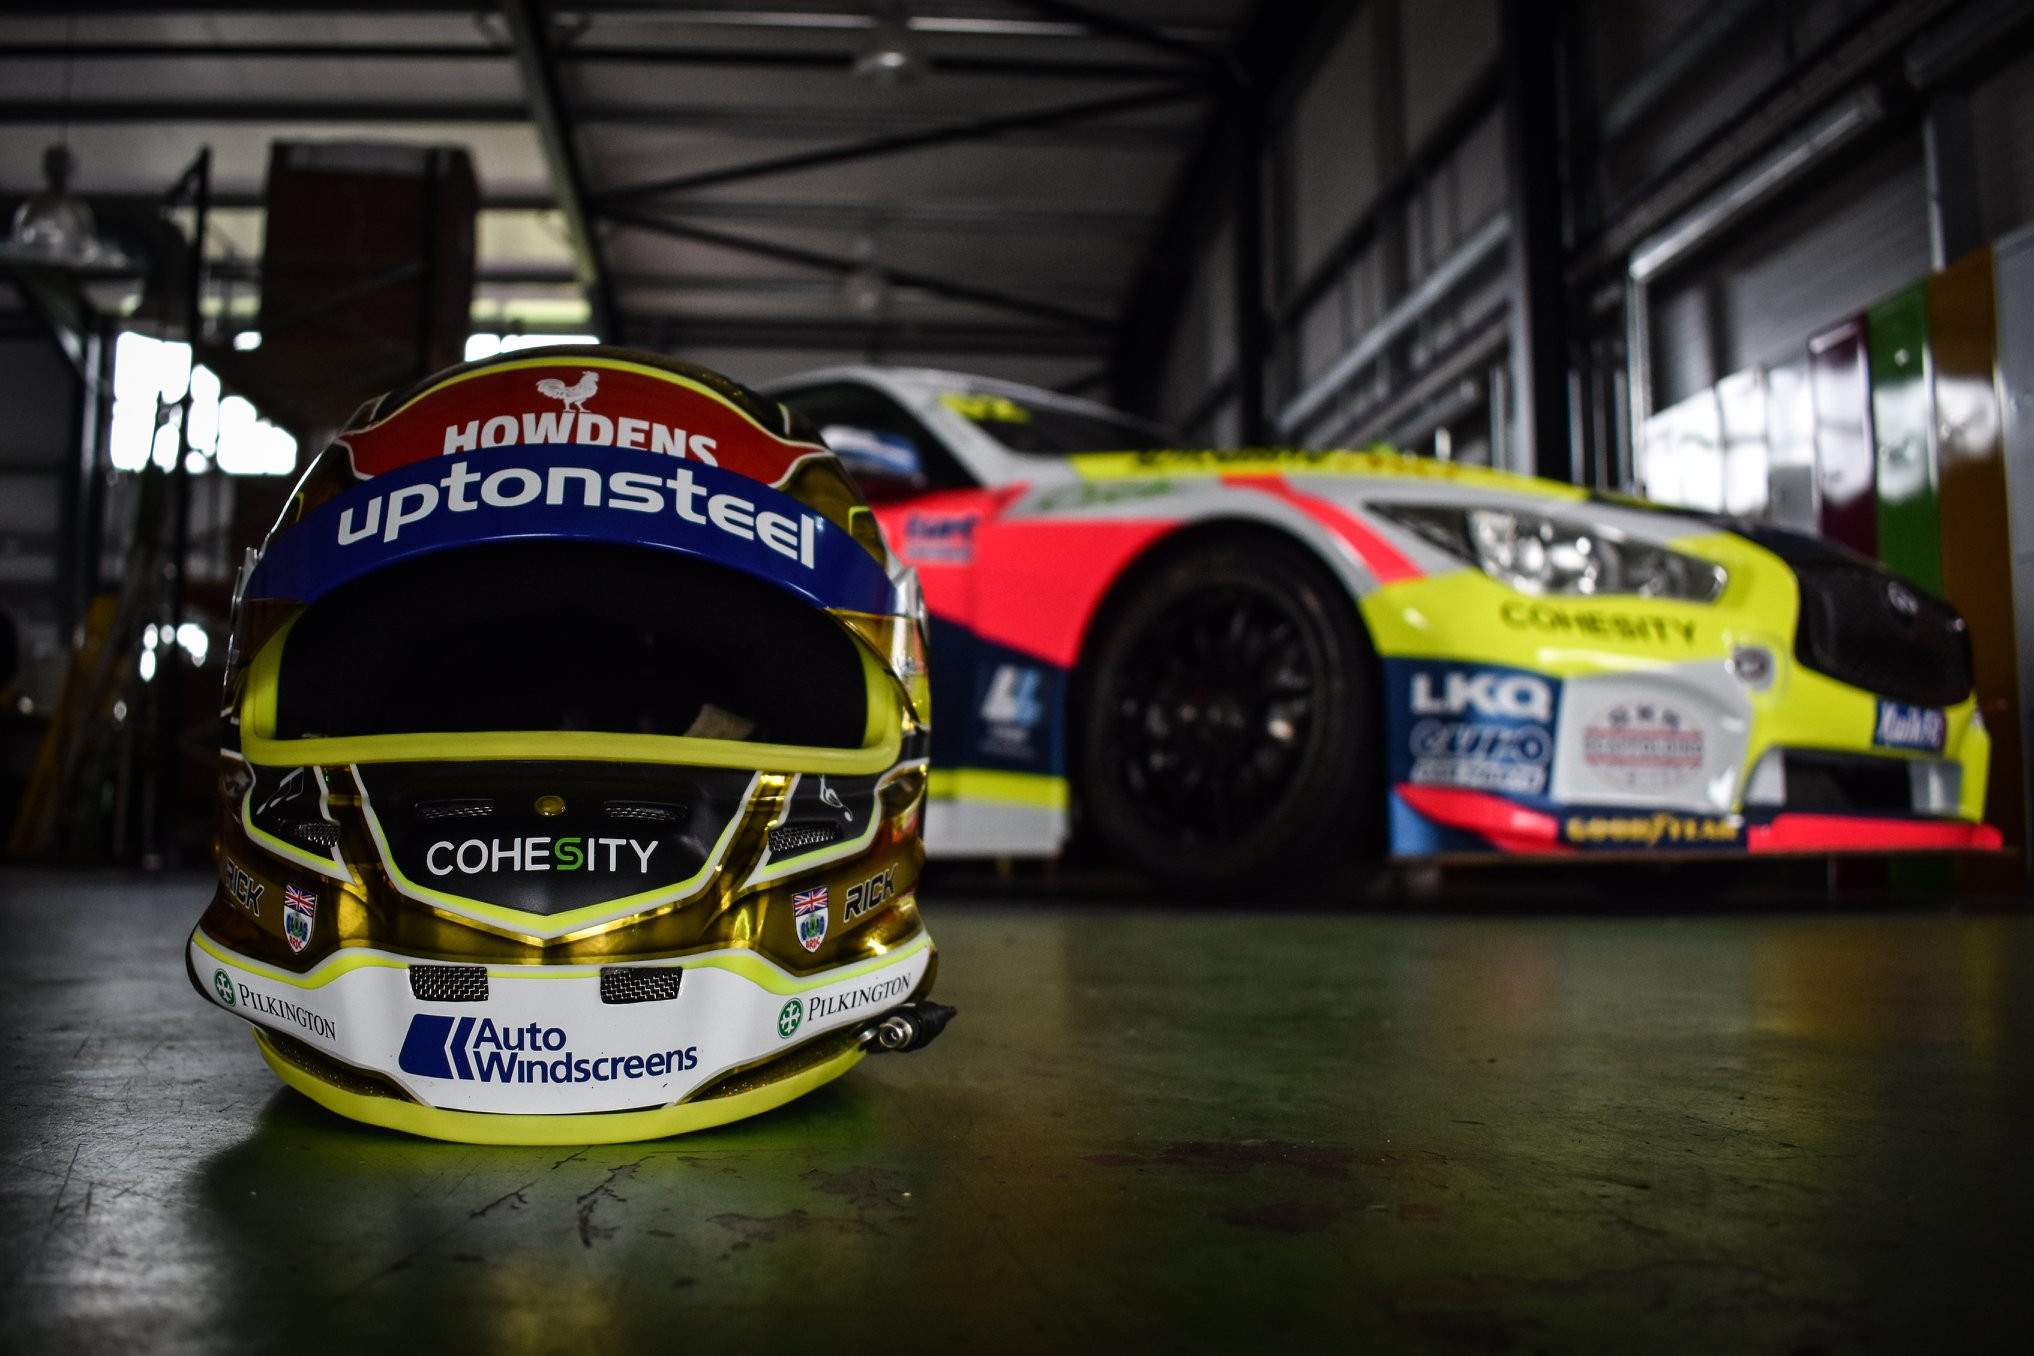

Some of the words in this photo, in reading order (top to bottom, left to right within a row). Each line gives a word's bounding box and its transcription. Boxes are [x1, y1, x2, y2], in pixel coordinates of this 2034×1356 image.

[442, 411, 718, 468] HOWDENS
[337, 460, 815, 570] uptonsteel
[1500, 601, 1696, 647] COHESITY
[1411, 672, 1553, 722] LKQ
[426, 836, 659, 877] COHESITY
[843, 862, 899, 924] RICK
[237, 982, 337, 1041] PILKINGTON
[807, 972, 912, 1022] PILKINGTON
[472, 1017, 567, 1052] Auto
[472, 1046, 698, 1083] Windscreens
